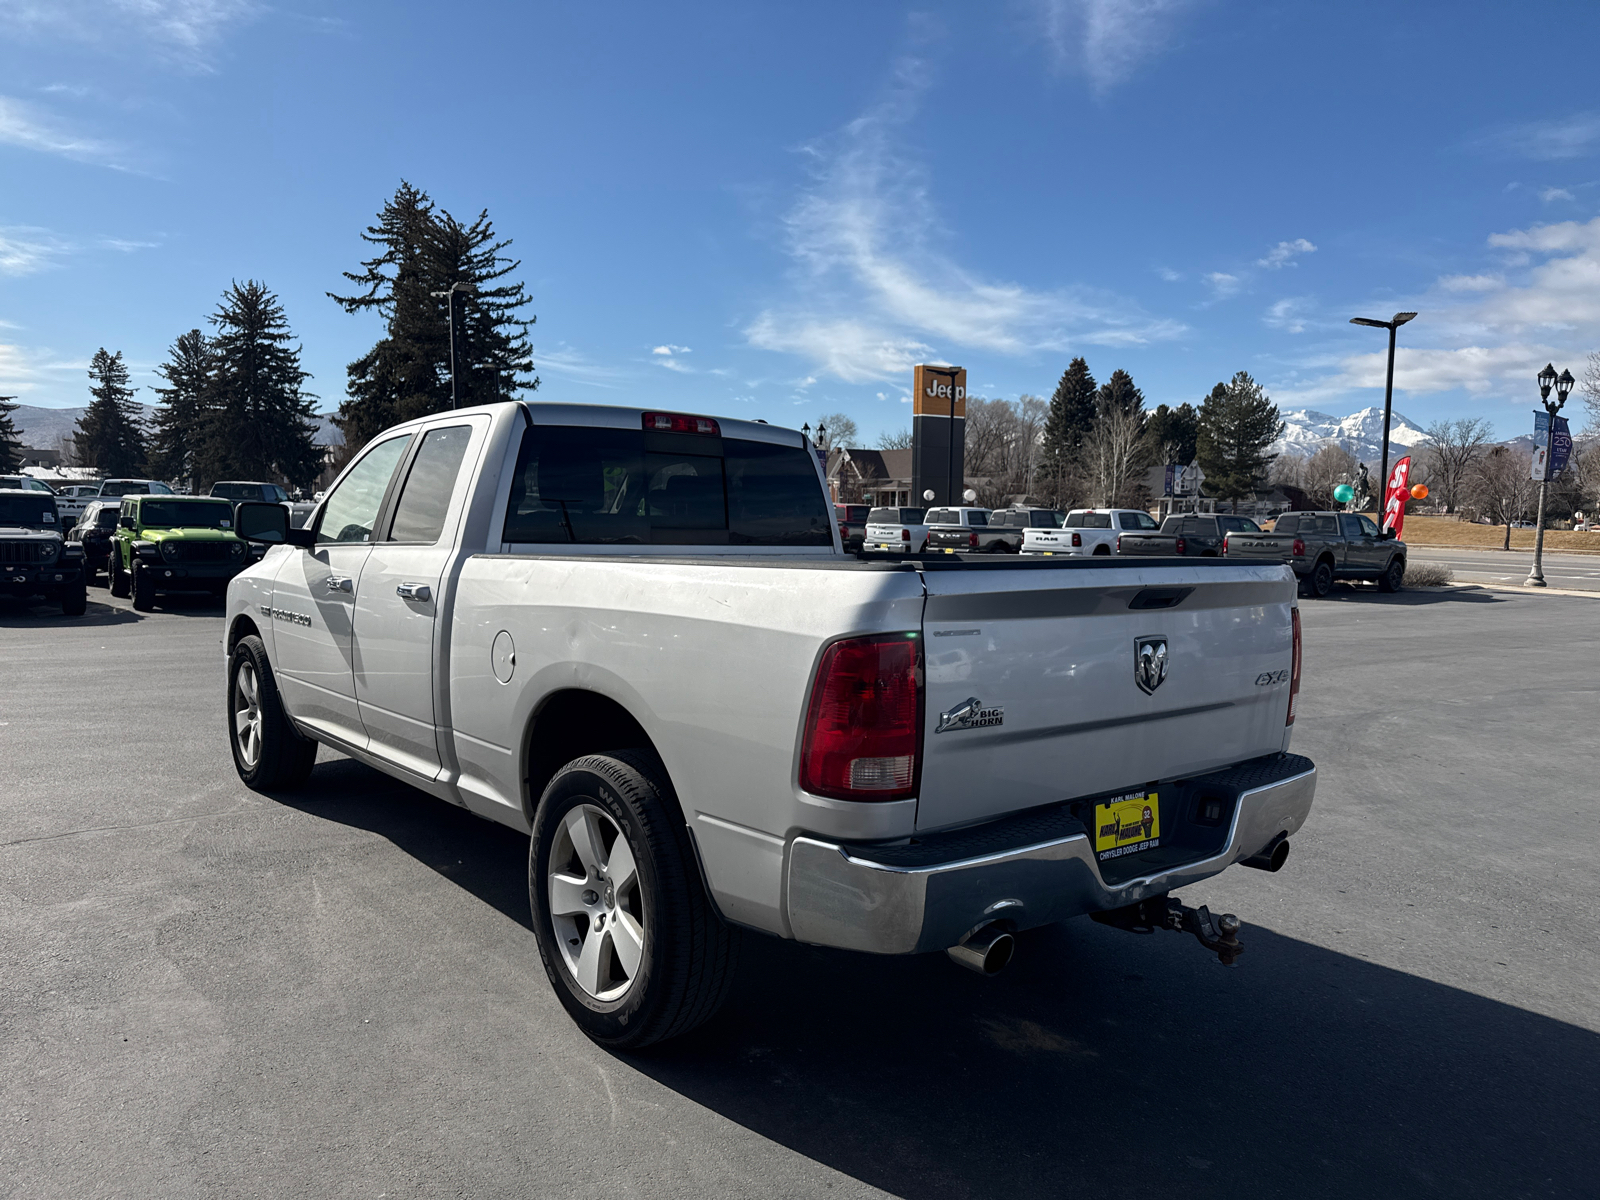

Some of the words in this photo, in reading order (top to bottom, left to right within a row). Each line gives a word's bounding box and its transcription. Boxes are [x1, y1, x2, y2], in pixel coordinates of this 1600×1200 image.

[926, 379, 965, 403] Jeep
[1553, 436, 1571, 448] 250
[980, 709, 999, 718] BIG
[971, 717, 1003, 727] HORN
[1125, 792, 1145, 800] MALONE
[1144, 810, 1150, 819] 32
[1100, 848, 1122, 860] CHRYSLER
[1123, 844, 1138, 854] DODGE
[1139, 842, 1149, 851] JEEP
[1150, 839, 1159, 848] RAM
